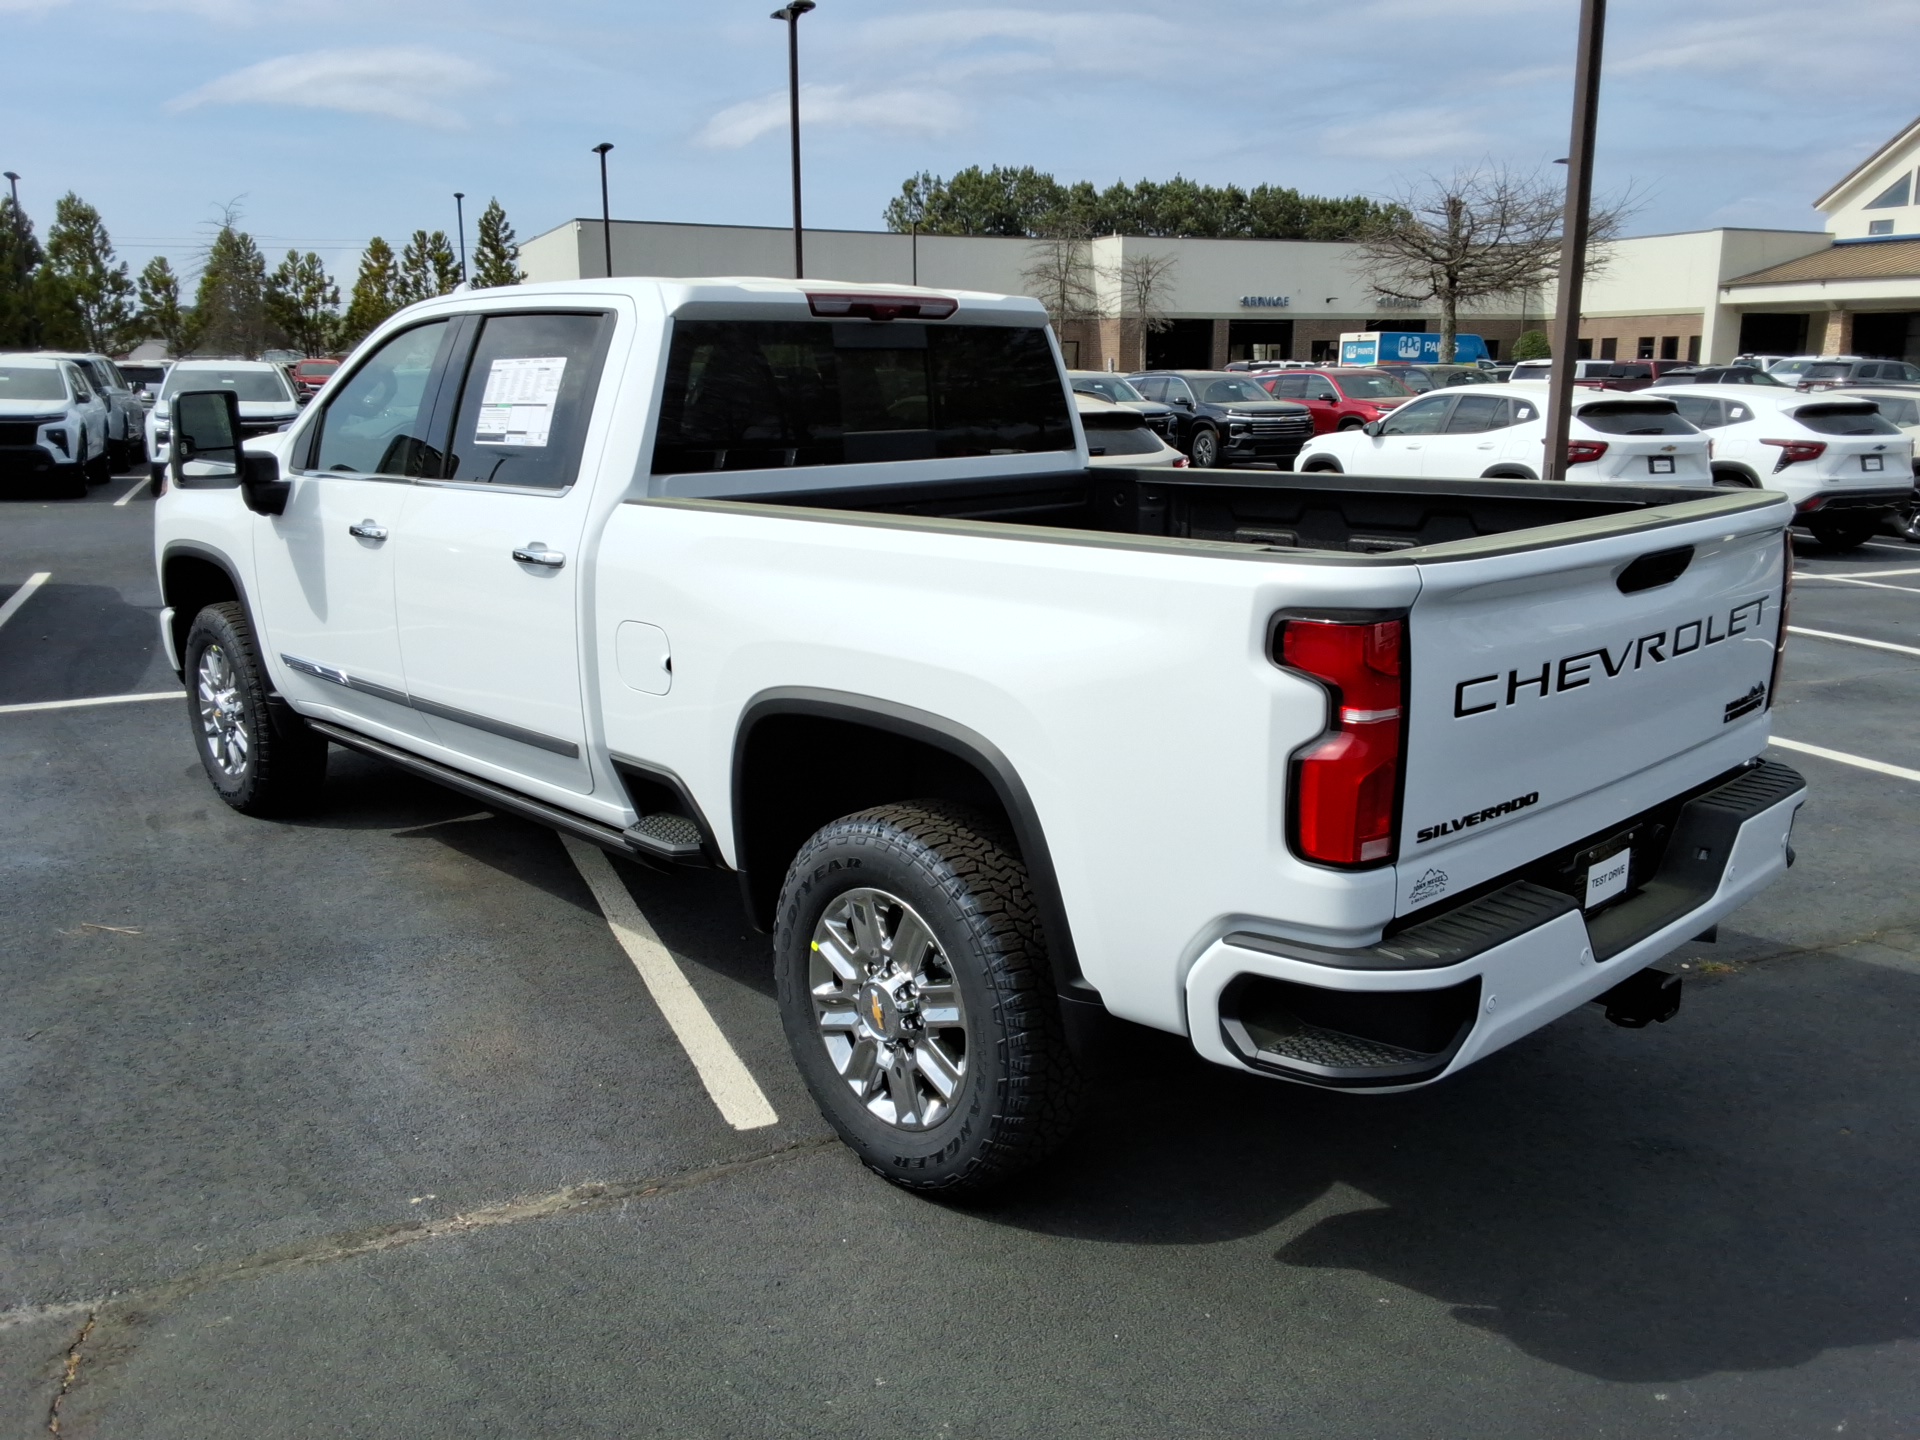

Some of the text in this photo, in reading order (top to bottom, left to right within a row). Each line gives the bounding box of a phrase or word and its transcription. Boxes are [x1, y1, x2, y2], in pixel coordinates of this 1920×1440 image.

[1240, 296, 1290, 307] SERVICE
[1357, 347, 1374, 355] PAINTS
[1399, 337, 1420, 355] PPG
[1454, 595, 1770, 718] CHEVROLET
[1416, 791, 1539, 844] SILVERADO
[1592, 864, 1625, 888] TEST DRIVE
